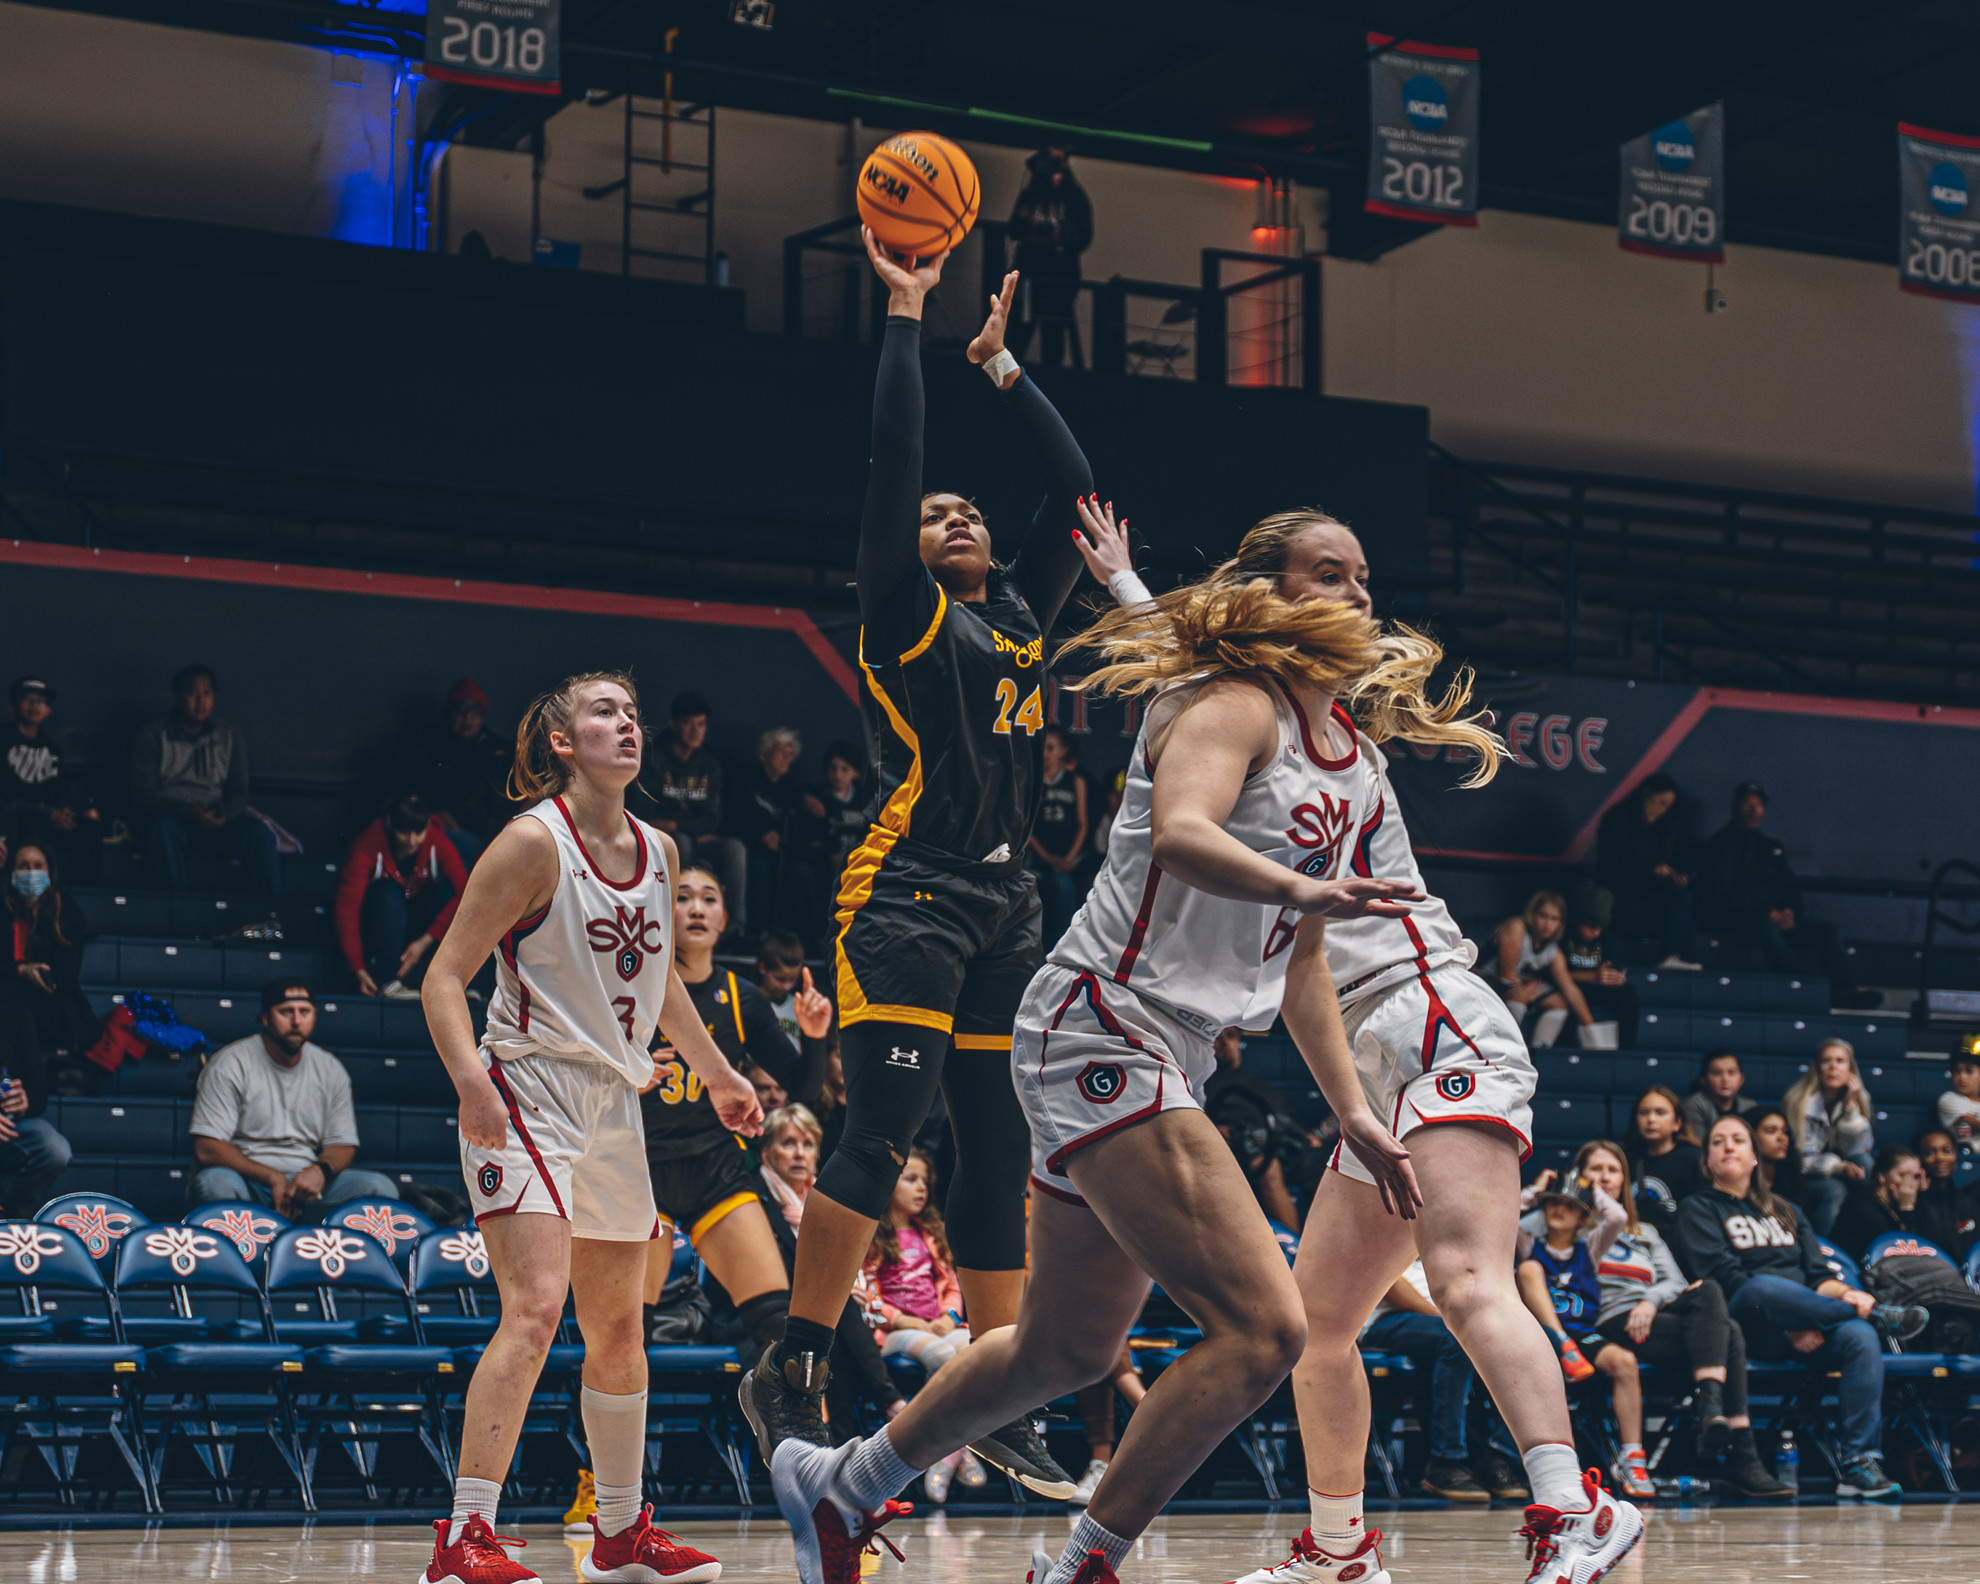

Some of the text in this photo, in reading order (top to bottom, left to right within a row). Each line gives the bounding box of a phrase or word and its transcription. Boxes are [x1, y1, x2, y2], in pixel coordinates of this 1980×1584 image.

[440, 15, 546, 73] 2018
[864, 162, 910, 204] NCAA
[1382, 156, 1464, 207] 2012
[1627, 193, 1717, 245] 2009
[992, 677, 1044, 737] 24
[586, 905, 663, 955] SMC
[622, 954, 632, 973] G
[1092, 1071, 1113, 1094] G
[1447, 1075, 1463, 1095] G
[55, 1204, 132, 1239] SMC
[343, 1204, 420, 1240] SMC
[144, 1226, 220, 1259] SMC
[294, 1228, 368, 1261] SMC
[438, 1230, 489, 1263] SM
